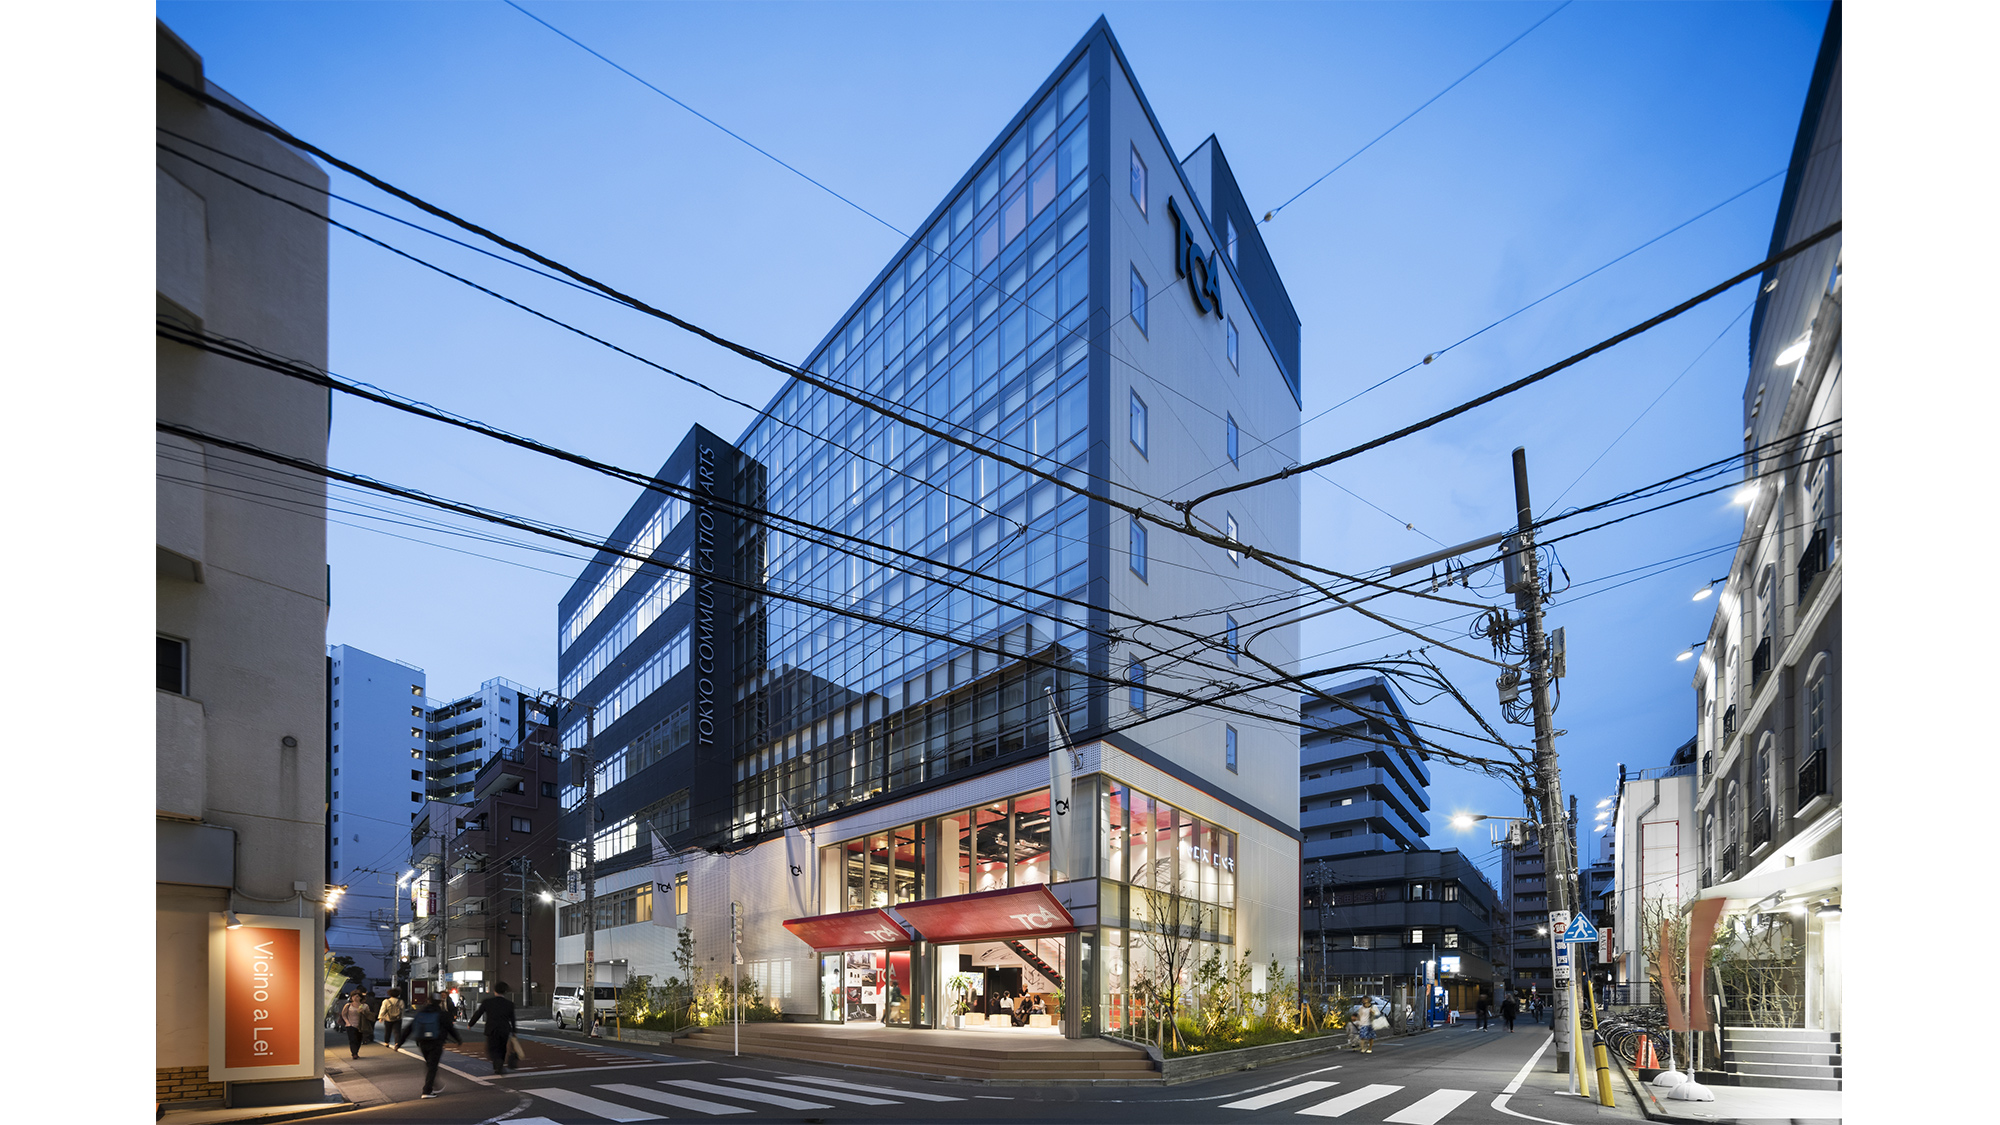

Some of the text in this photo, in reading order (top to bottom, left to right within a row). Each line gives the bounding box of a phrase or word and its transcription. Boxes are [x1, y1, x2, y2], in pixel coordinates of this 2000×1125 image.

[1167, 195, 1224, 320] TCA
[698, 444, 715, 746] TOKYO COMMUNCATION ARTS
[1055, 797, 1070, 816] CA
[790, 865, 803, 877] CA
[656, 882, 673, 893] TCA
[1009, 905, 1061, 930] TCA
[864, 924, 899, 943] TCA
[253, 941, 274, 1056] Vicino a Lei
